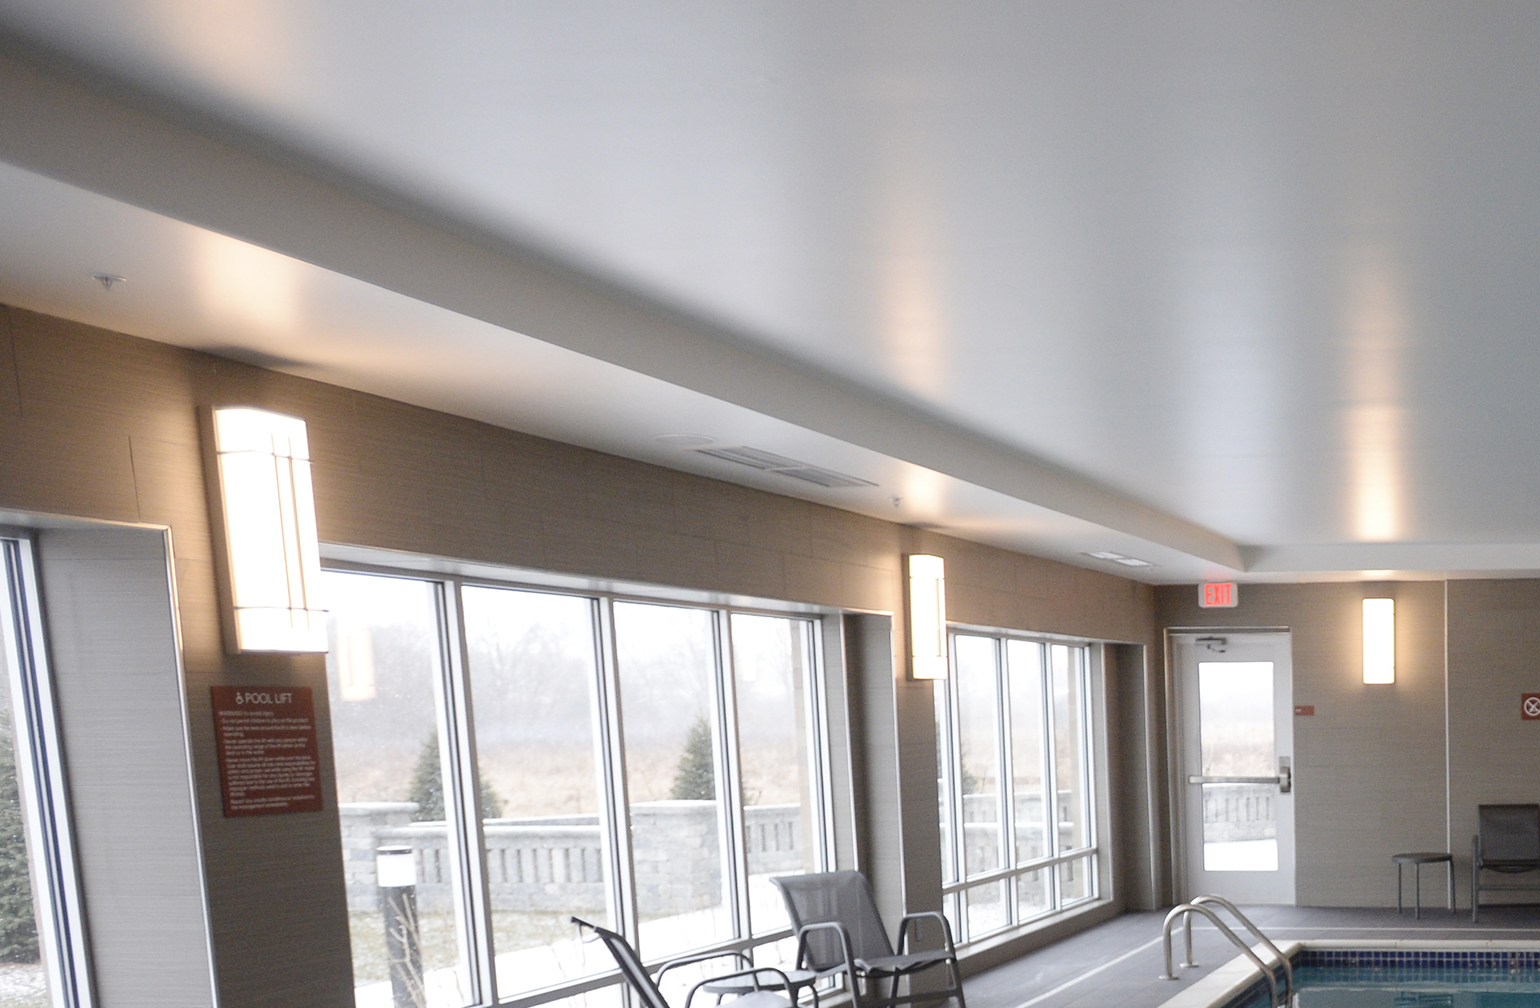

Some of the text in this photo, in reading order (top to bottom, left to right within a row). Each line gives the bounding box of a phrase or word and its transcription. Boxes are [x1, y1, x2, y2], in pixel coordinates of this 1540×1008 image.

[1204, 583, 1233, 606] EXIT
[246, 693, 292, 704] POOL LIFT
